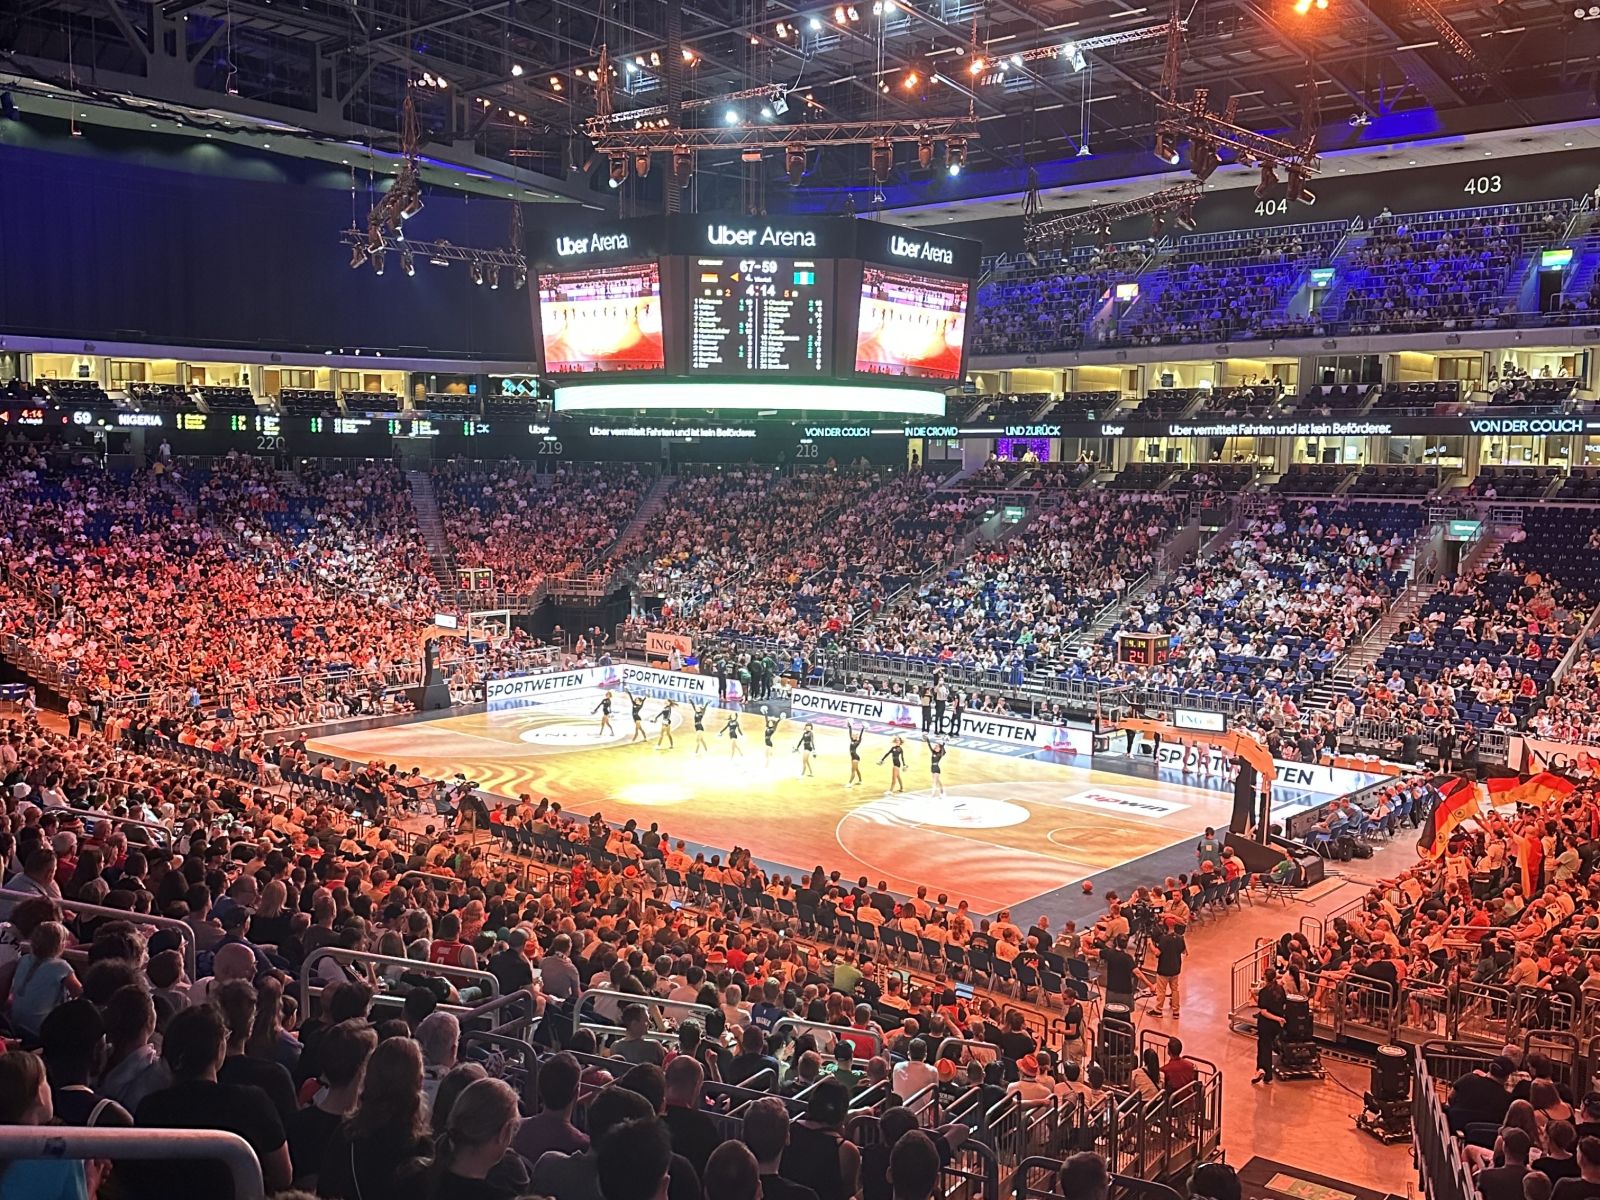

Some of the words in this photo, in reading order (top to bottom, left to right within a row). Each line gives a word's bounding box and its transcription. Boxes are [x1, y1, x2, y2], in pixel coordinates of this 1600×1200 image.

[1464, 176, 1502, 195] 403
[1254, 199, 1288, 217] 404
[707, 224, 757, 246] Uber
[759, 226, 816, 247] Arena
[556, 237, 588, 256] Uber
[590, 233, 629, 252] Arena
[890, 235, 920, 258] Uber
[920, 241, 953, 265] Arena
[745, 284, 777, 297] 4:14
[73, 411, 92, 425] 59
[118, 413, 163, 427] NIGERIA
[528, 425, 550, 435] Uber
[589, 426, 610, 436] Uber
[646, 427, 675, 437] Fahrten
[675, 428, 691, 437] und
[804, 427, 824, 437] VON
[824, 427, 841, 437] DER
[841, 427, 870, 437] COUCH
[905, 426, 914, 437] IN
[914, 426, 926, 437] DIE
[926, 426, 958, 437] CROWD
[1005, 426, 1025, 436] UND
[1025, 424, 1061, 437] ZURÜCK
[1101, 424, 1124, 436] Uber
[1169, 424, 1192, 436] Uber
[1193, 424, 1238, 436] vermittelt
[1238, 424, 1276, 435] Fahrten
[1276, 424, 1297, 434] und
[1297, 423, 1310, 434] ist
[1310, 423, 1332, 434] kein
[1469, 420, 1500, 432] VON
[1501, 420, 1528, 432] DER
[1529, 419, 1583, 432] COUCH
[256, 436, 285, 450] 220
[538, 441, 563, 455] 219
[796, 444, 819, 458] 218
[651, 638, 671, 650] ING
[1129, 650, 1145, 663] 24
[487, 674, 584, 698] SPORTWETTEN
[622, 668, 706, 692] SPORTWETTEN
[793, 693, 883, 718] PORTWETTEN
